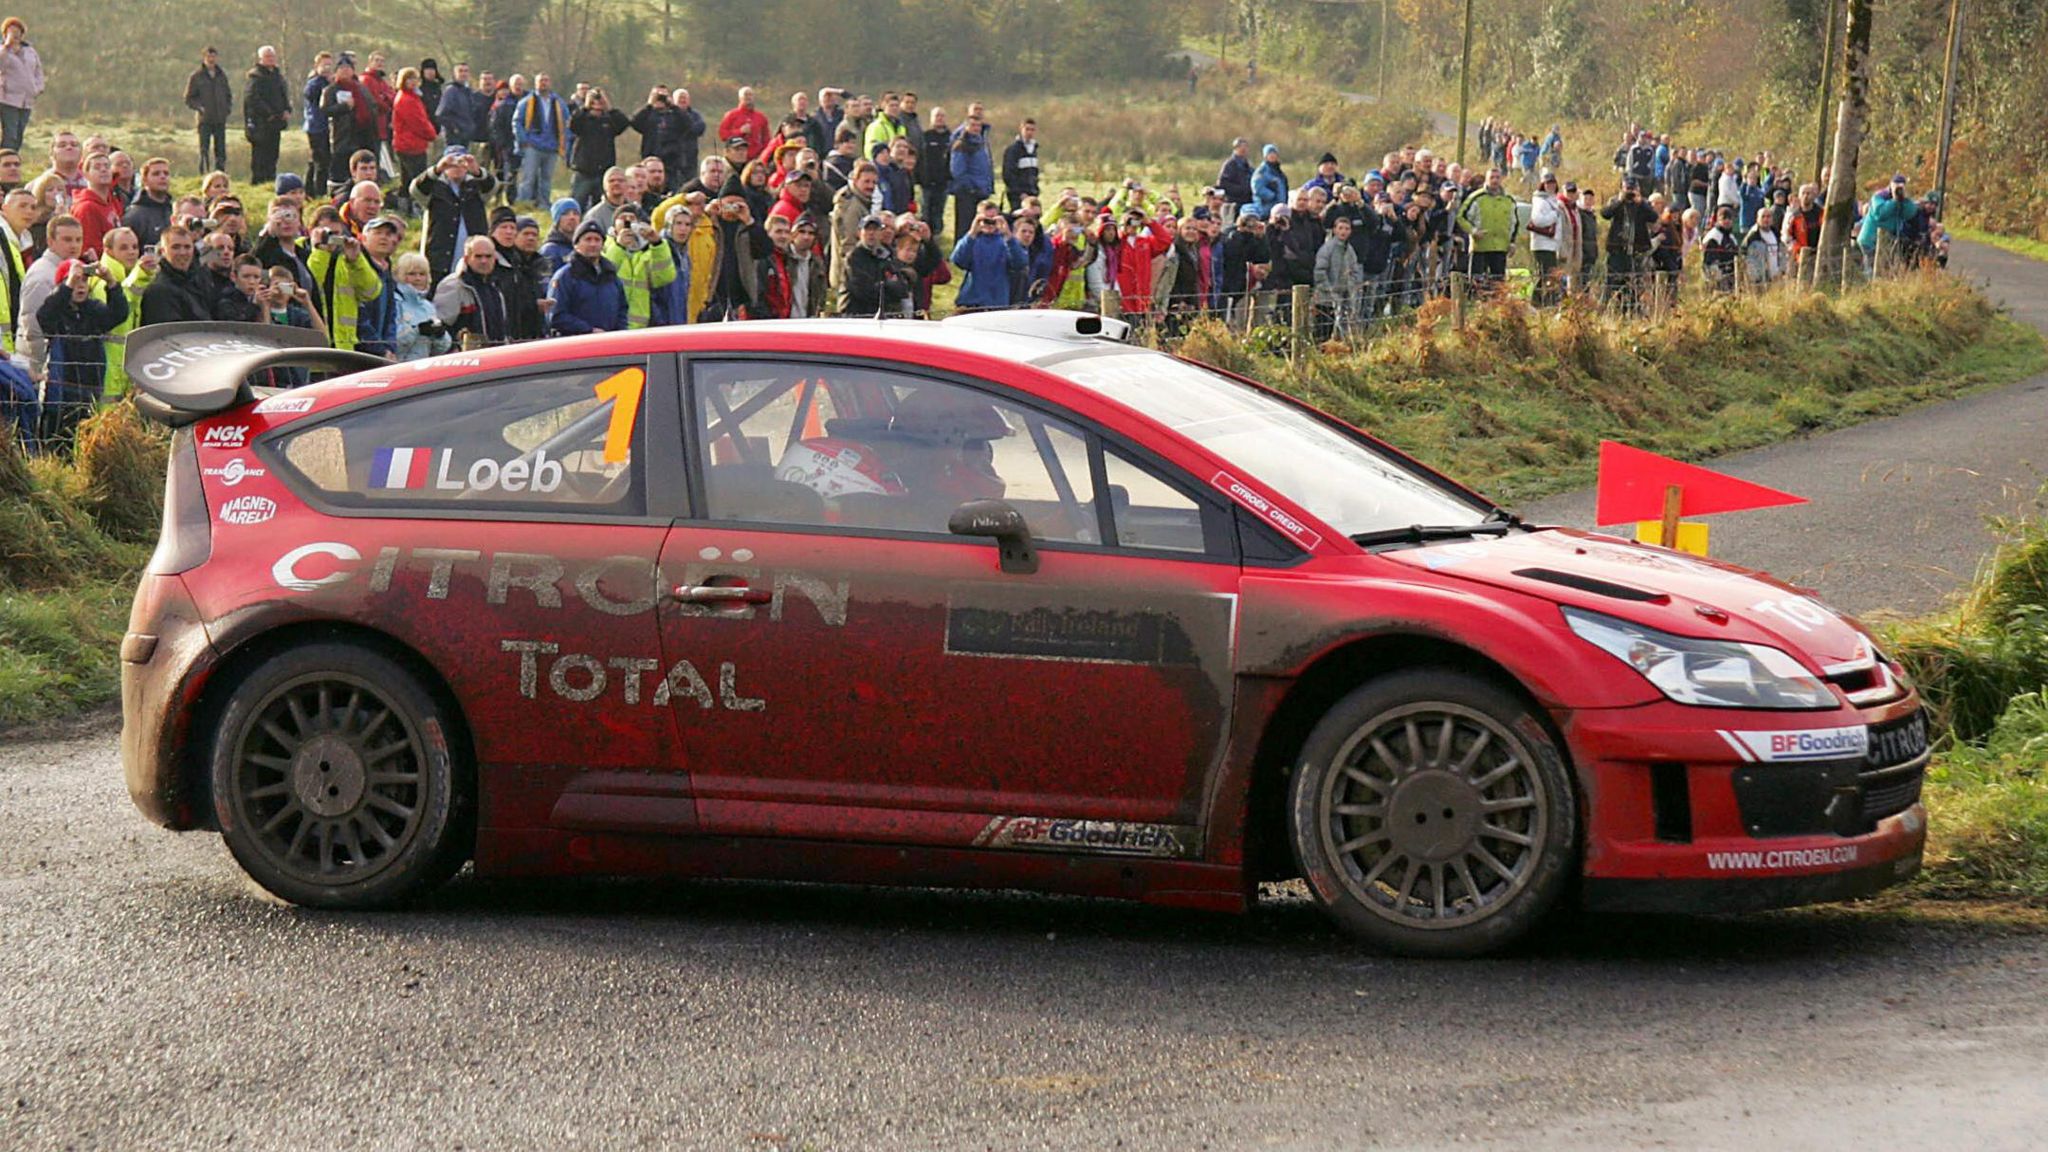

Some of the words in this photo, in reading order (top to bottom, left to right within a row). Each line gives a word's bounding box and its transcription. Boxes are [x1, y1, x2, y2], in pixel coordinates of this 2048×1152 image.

[594, 366, 645, 464] 1
[204, 425, 250, 441] NGK
[436, 447, 563, 493] Loeb
[1269, 510, 1304, 535] CREDIT
[272, 541, 850, 626] CITROËN
[501, 640, 766, 712] TOTAL
[1771, 730, 1865, 752] BFGoodrich
[1708, 846, 1857, 869] WWW.CITROEN.COM
